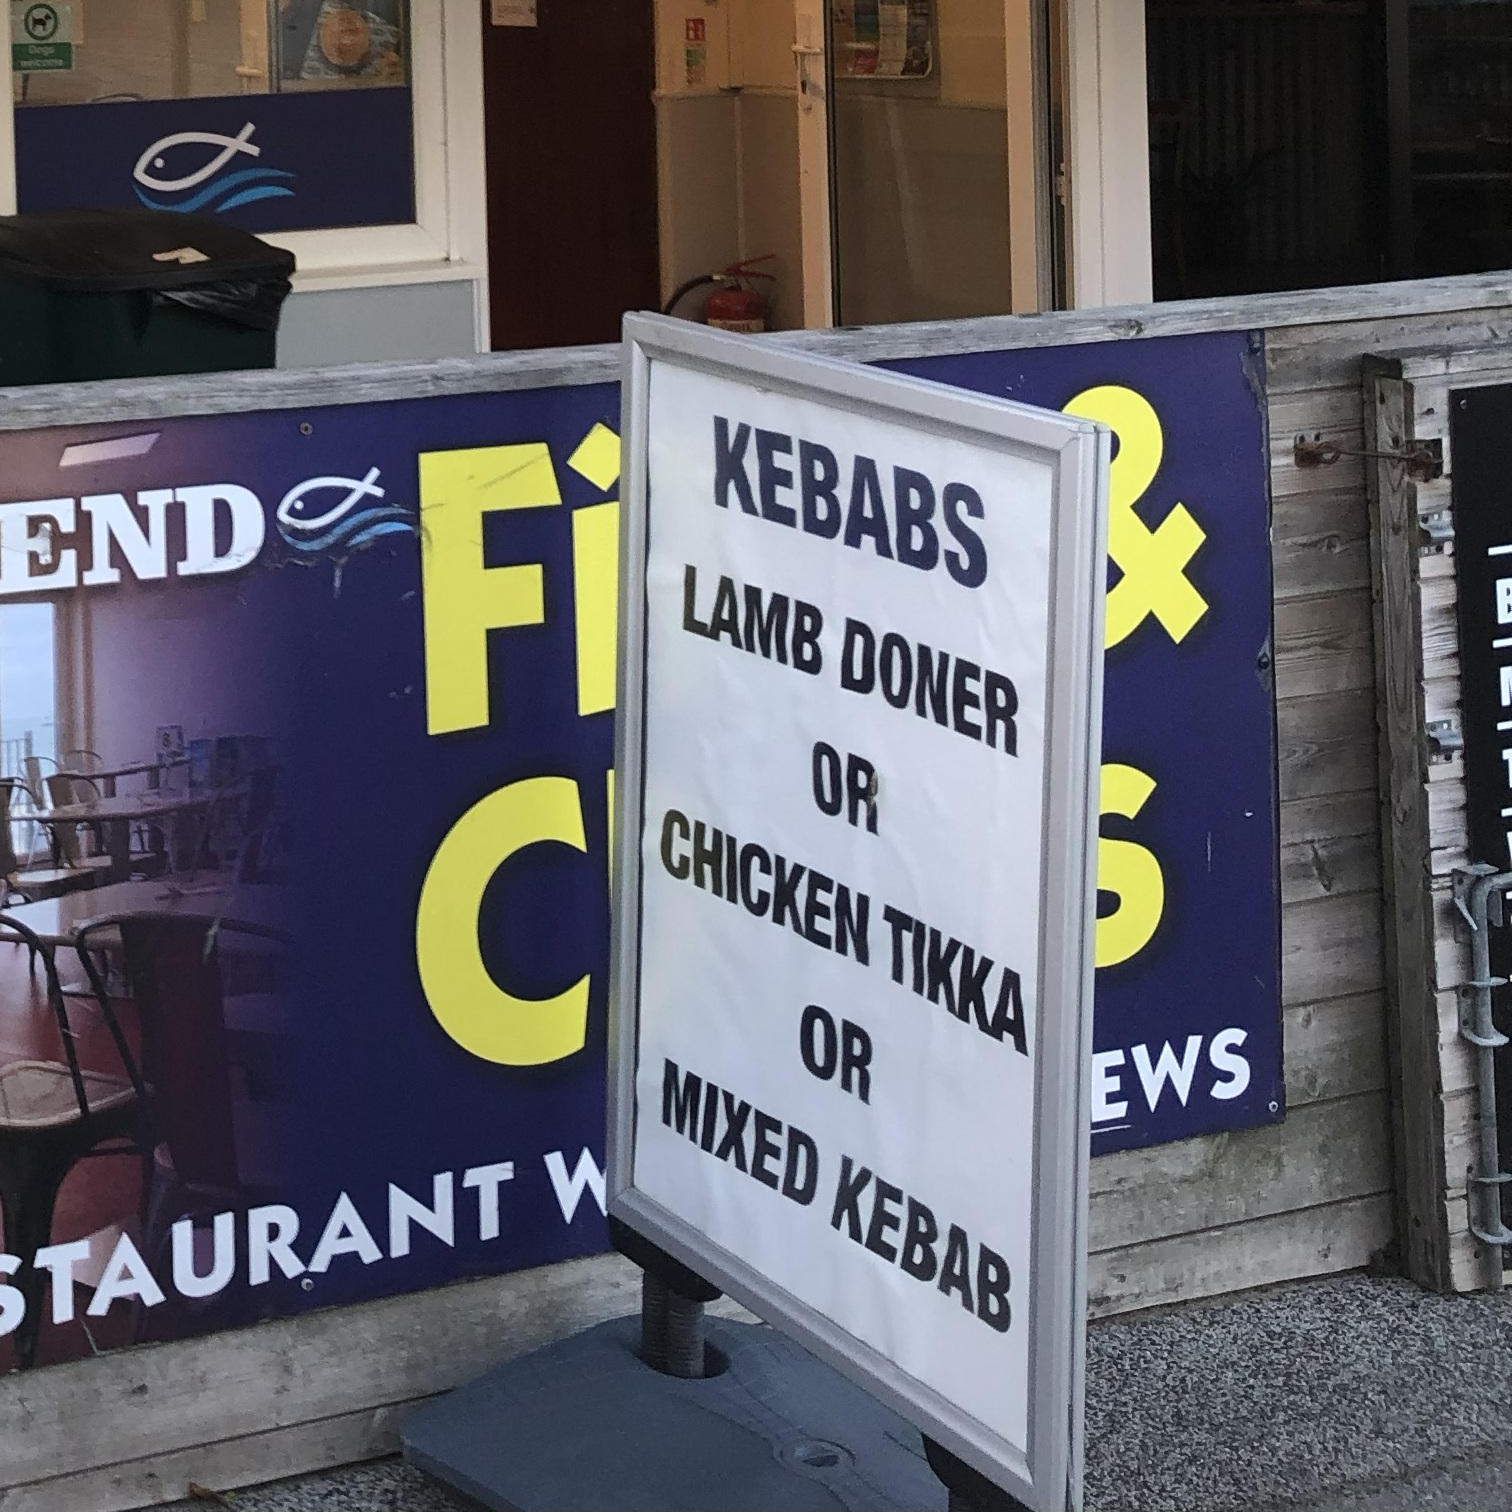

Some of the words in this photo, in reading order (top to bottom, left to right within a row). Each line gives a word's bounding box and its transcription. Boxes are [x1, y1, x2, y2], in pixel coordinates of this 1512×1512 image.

[712, 415, 989, 590] KEBABS
[682, 564, 824, 676] LAMB
[840, 617, 1019, 758] DONER
[811, 740, 880, 835] OR
[660, 809, 870, 967] CHICKEN
[883, 904, 1029, 1057] TIKKA
[799, 1003, 873, 1105] OR
[1090, 1027, 1252, 1123] EWS
[662, 1057, 819, 1208] MIXED
[830, 1154, 1013, 1335] KEBAB
